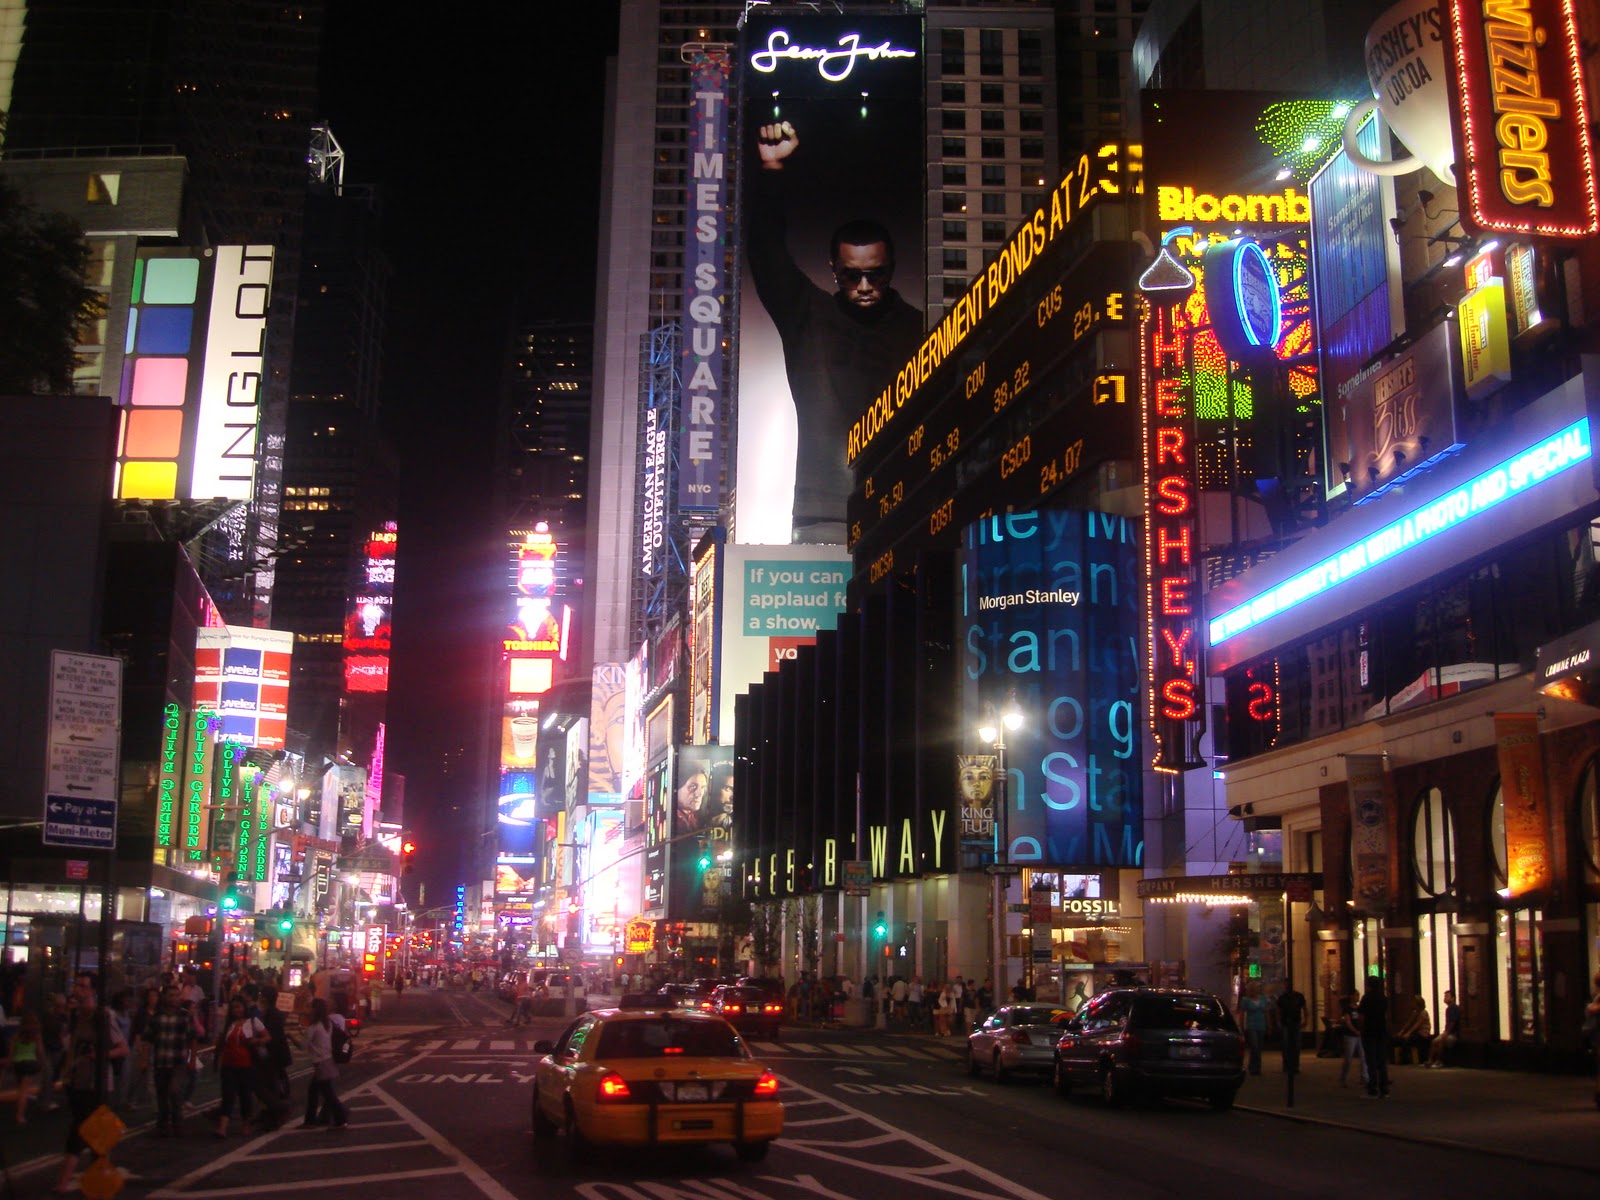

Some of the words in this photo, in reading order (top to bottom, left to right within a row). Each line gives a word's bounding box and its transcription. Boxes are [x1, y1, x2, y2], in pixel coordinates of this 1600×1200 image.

[751, 30, 826, 72] Sean
[818, 34, 916, 81] John
[1386, 56, 1433, 106] COCOA
[693, 91, 724, 243] TIMES
[1157, 186, 1311, 222] Bloomb
[862, 392, 894, 446] LOCAL
[895, 275, 986, 408] GOVERNMENT
[988, 208, 1045, 308] BONDS
[1050, 171, 1074, 241] AT
[218, 245, 273, 481] INGLOT
[689, 262, 721, 460] SQUARE
[993, 360, 1030, 413] 38.22
[646, 408, 657, 468] EAGLE
[1040, 439, 1084, 494] 24.07
[653, 430, 666, 548] OUTFITTERS
[688, 483, 712, 494] NYC
[1367, 526, 1401, 562] WITH
[1403, 519, 1414, 545] A
[1415, 490, 1468, 539] PHOTO
[1472, 470, 1507, 510] AND
[1509, 428, 1588, 489] SPECIAL
[642, 473, 655, 576] AMERICAN
[930, 499, 954, 535] COST
[1153, 332, 1194, 719] HERSHEY'S
[750, 568, 764, 583] If
[769, 571, 804, 586] you
[810, 571, 844, 583] can
[749, 591, 828, 608] applaud
[979, 593, 1024, 610] Morgan
[1025, 588, 1080, 607] Stanley
[749, 617, 760, 629] a
[503, 640, 559, 651] TOSHIBA
[1570, 649, 1590, 668] PLAZA
[193, 719, 208, 775] OLIVE
[221, 749, 235, 798] OLIVE
[64, 802, 84, 816] Pay
[86, 805, 97, 815] at
[187, 780, 204, 847] GARDEN
[243, 773, 254, 816] OLIE
[259, 791, 270, 830] OLIVE
[961, 807, 993, 819] KING
[48, 824, 112, 839] Muni-Meter
[961, 819, 994, 833] TUT
[1063, 900, 1118, 913] FOSSIL
[369, 928, 383, 953] tkts
[397, 1073, 535, 1085] ONLY
